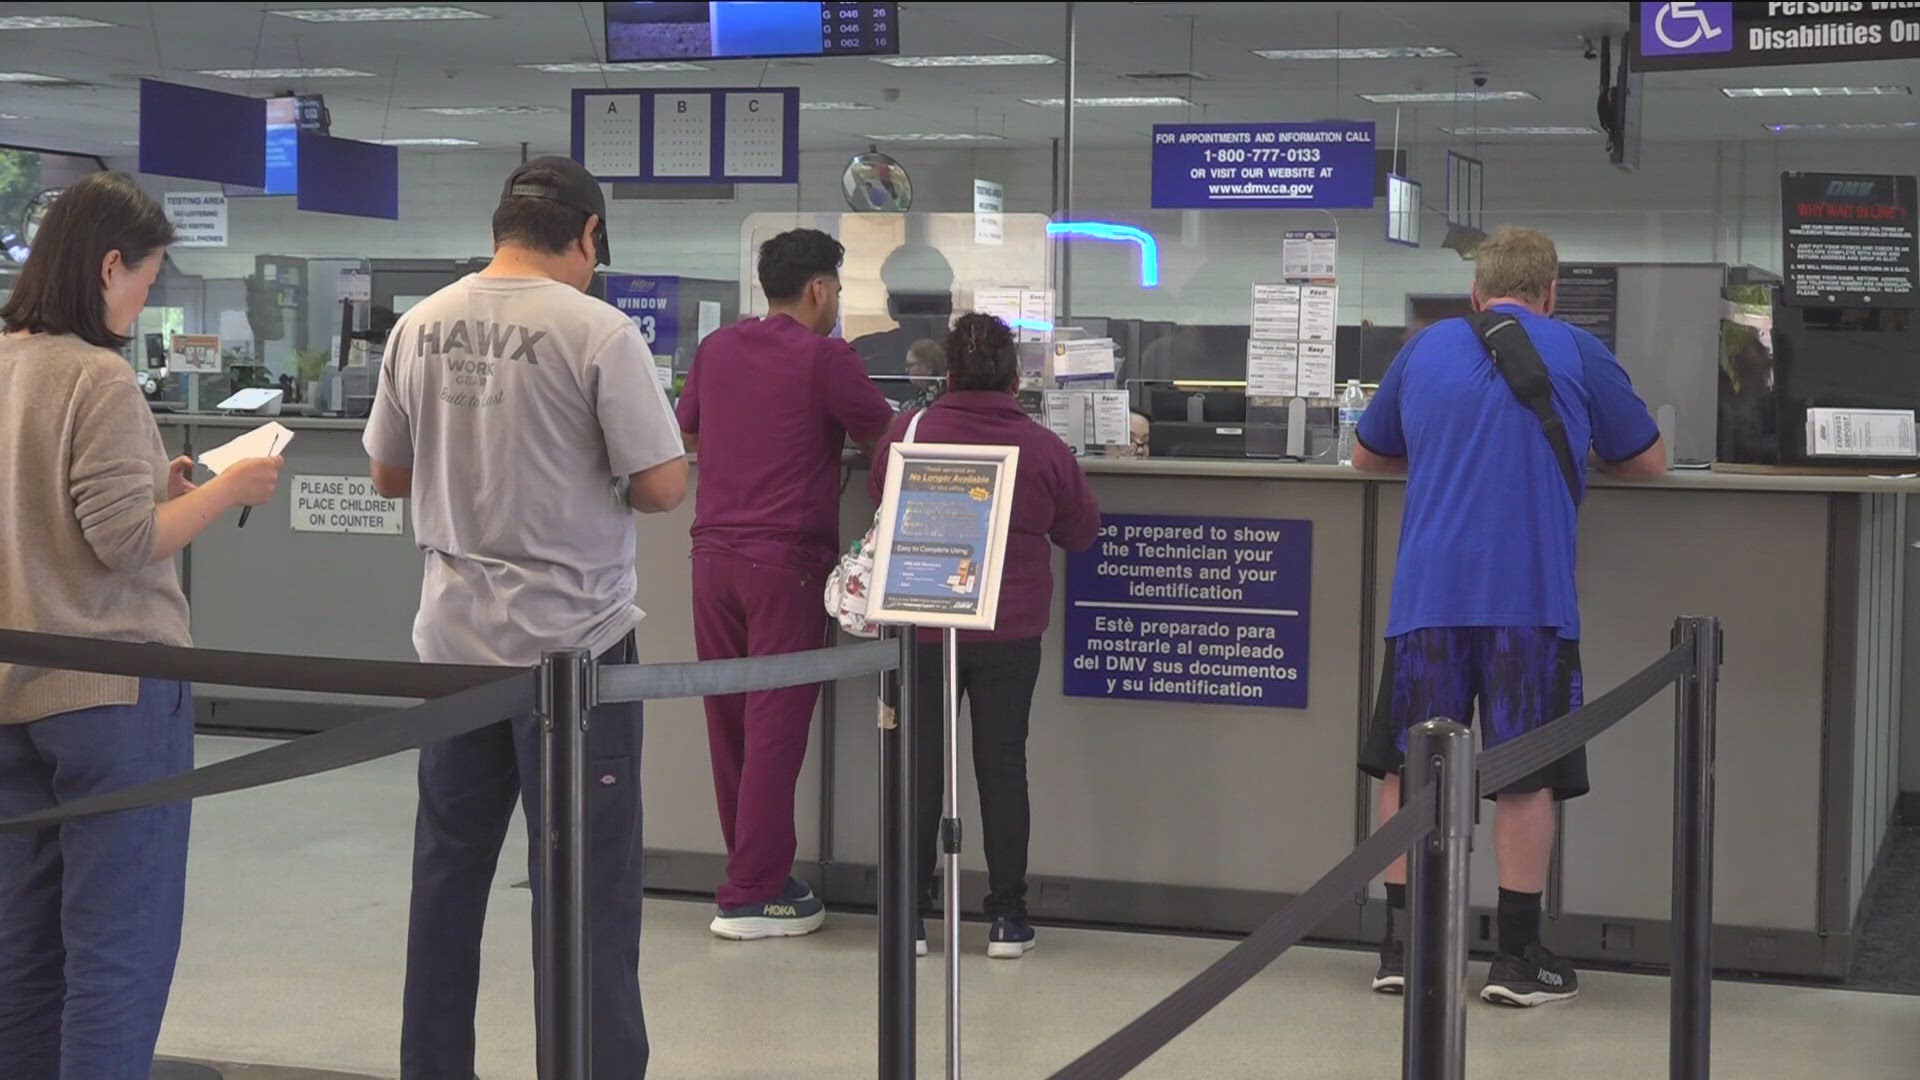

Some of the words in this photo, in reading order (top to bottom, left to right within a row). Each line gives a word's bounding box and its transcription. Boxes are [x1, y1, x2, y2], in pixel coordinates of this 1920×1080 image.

[823, 10, 831, 19] G
[839, 10, 858, 19] 046
[873, 9, 886, 17] 26
[823, 25, 831, 34] G
[840, 24, 859, 33] 046
[874, 23, 886, 32] 26
[1750, 22, 1882, 50] Disabilities
[824, 40, 831, 48] B
[841, 39, 859, 47] 062
[875, 38, 886, 46] 16
[607, 102, 617, 114] A
[677, 101, 687, 113] B
[749, 100, 759, 112] C
[1156, 133, 1175, 144] FOR
[1179, 132, 1250, 143] APPOINTMENTS
[1255, 132, 1275, 142] AND
[1279, 132, 1342, 142] INFORMATION
[1346, 132, 1370, 142] CALL
[1190, 168, 1206, 178] OR
[1211, 168, 1236, 178] VISIT
[1241, 168, 1263, 178] OUR
[1268, 168, 1315, 178] WEBSITE
[1320, 168, 1333, 178] AT
[1209, 182, 1313, 196] www.dmv.ca.gov
[168, 197, 201, 205] TESTING
[203, 197, 224, 205] AREA
[1798, 202, 1824, 217] WHY
[1826, 204, 1853, 218] WAIT
[1856, 205, 1869, 218] IN
[1871, 205, 1895, 218] LINE
[617, 298, 667, 309] WINDOW
[418, 320, 546, 366] HAWX
[448, 360, 494, 375] WORK
[456, 376, 487, 386] GEAR
[468, 396, 480, 408] to
[1835, 416, 1843, 448] EXPRESS
[1843, 416, 1851, 447] DEPOSIT
[909, 473, 921, 482] No
[922, 473, 950, 483] Longer
[952, 474, 990, 484] Available
[301, 482, 343, 494] PLEASE
[349, 484, 365, 495] DO
[299, 498, 335, 510] PLACE
[340, 500, 395, 512] CHILDREN
[310, 514, 325, 525] ON
[331, 514, 384, 527] COUNTER
[1124, 525, 1203, 540] prepared
[1210, 526, 1227, 540] to
[1234, 527, 1280, 542] show
[897, 545, 911, 553] Easy
[920, 546, 949, 554] Complete
[950, 547, 967, 556] Using
[1102, 542, 1129, 556] the
[1136, 542, 1227, 560] Technician
[1234, 548, 1273, 564] your
[1097, 561, 1192, 578] documents
[1199, 565, 1231, 580] and
[1238, 568, 1277, 584] your
[1129, 581, 1243, 600] identification
[1140, 620, 1230, 636] preparado
[1236, 626, 1276, 641] para
[1087, 638, 1171, 654] mostrarle
[1177, 641, 1192, 655] al
[1198, 644, 1284, 660] empleado
[1073, 655, 1099, 670] del
[1106, 657, 1146, 672] DMV
[1153, 661, 1183, 674] sus
[1189, 660, 1298, 680] documentos
[1107, 680, 1116, 693] y
[1122, 677, 1144, 691] su
[1149, 678, 1263, 698] identification
[763, 904, 796, 916] HOKA
[1537, 968, 1563, 987] HOKA
